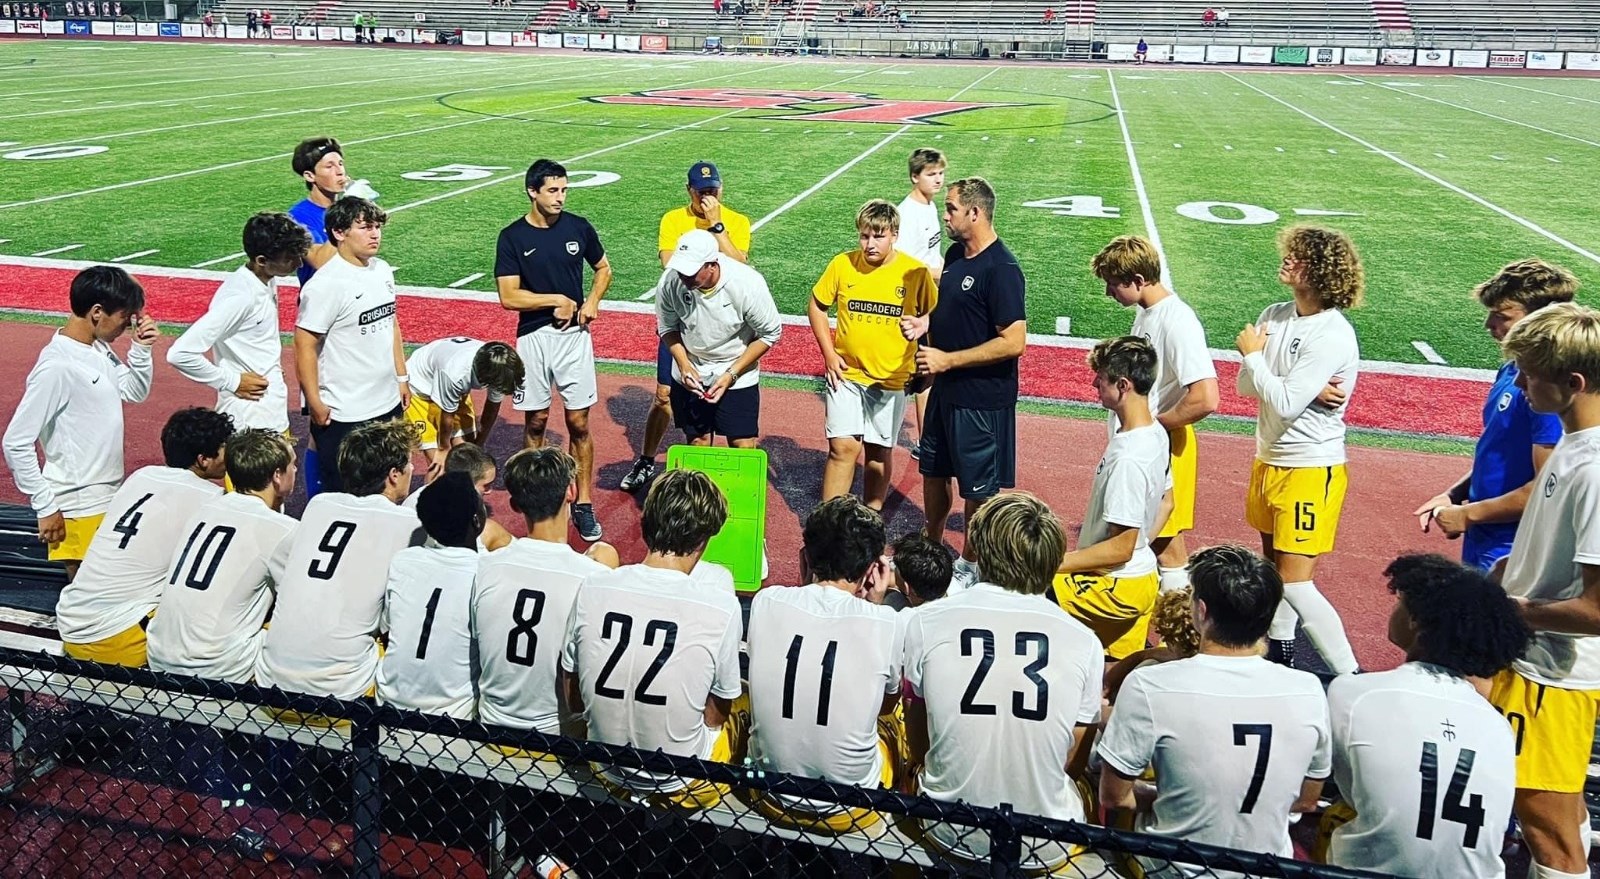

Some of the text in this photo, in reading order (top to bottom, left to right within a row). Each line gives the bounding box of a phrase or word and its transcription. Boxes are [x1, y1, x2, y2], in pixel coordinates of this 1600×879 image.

[906, 40, 958, 50] LA SALLE
[849, 301, 902, 316] CRUSADERS
[113, 493, 154, 549] 4
[308, 520, 357, 580] 9
[1295, 501, 1315, 531] 15
[169, 521, 236, 591] 10
[416, 587, 443, 660] 1
[506, 588, 546, 667] 8
[595, 611, 678, 706] 22
[782, 634, 838, 726] 11
[960, 628, 1049, 721] 23
[1232, 723, 1272, 814] 7
[1416, 741, 1485, 849] 14
